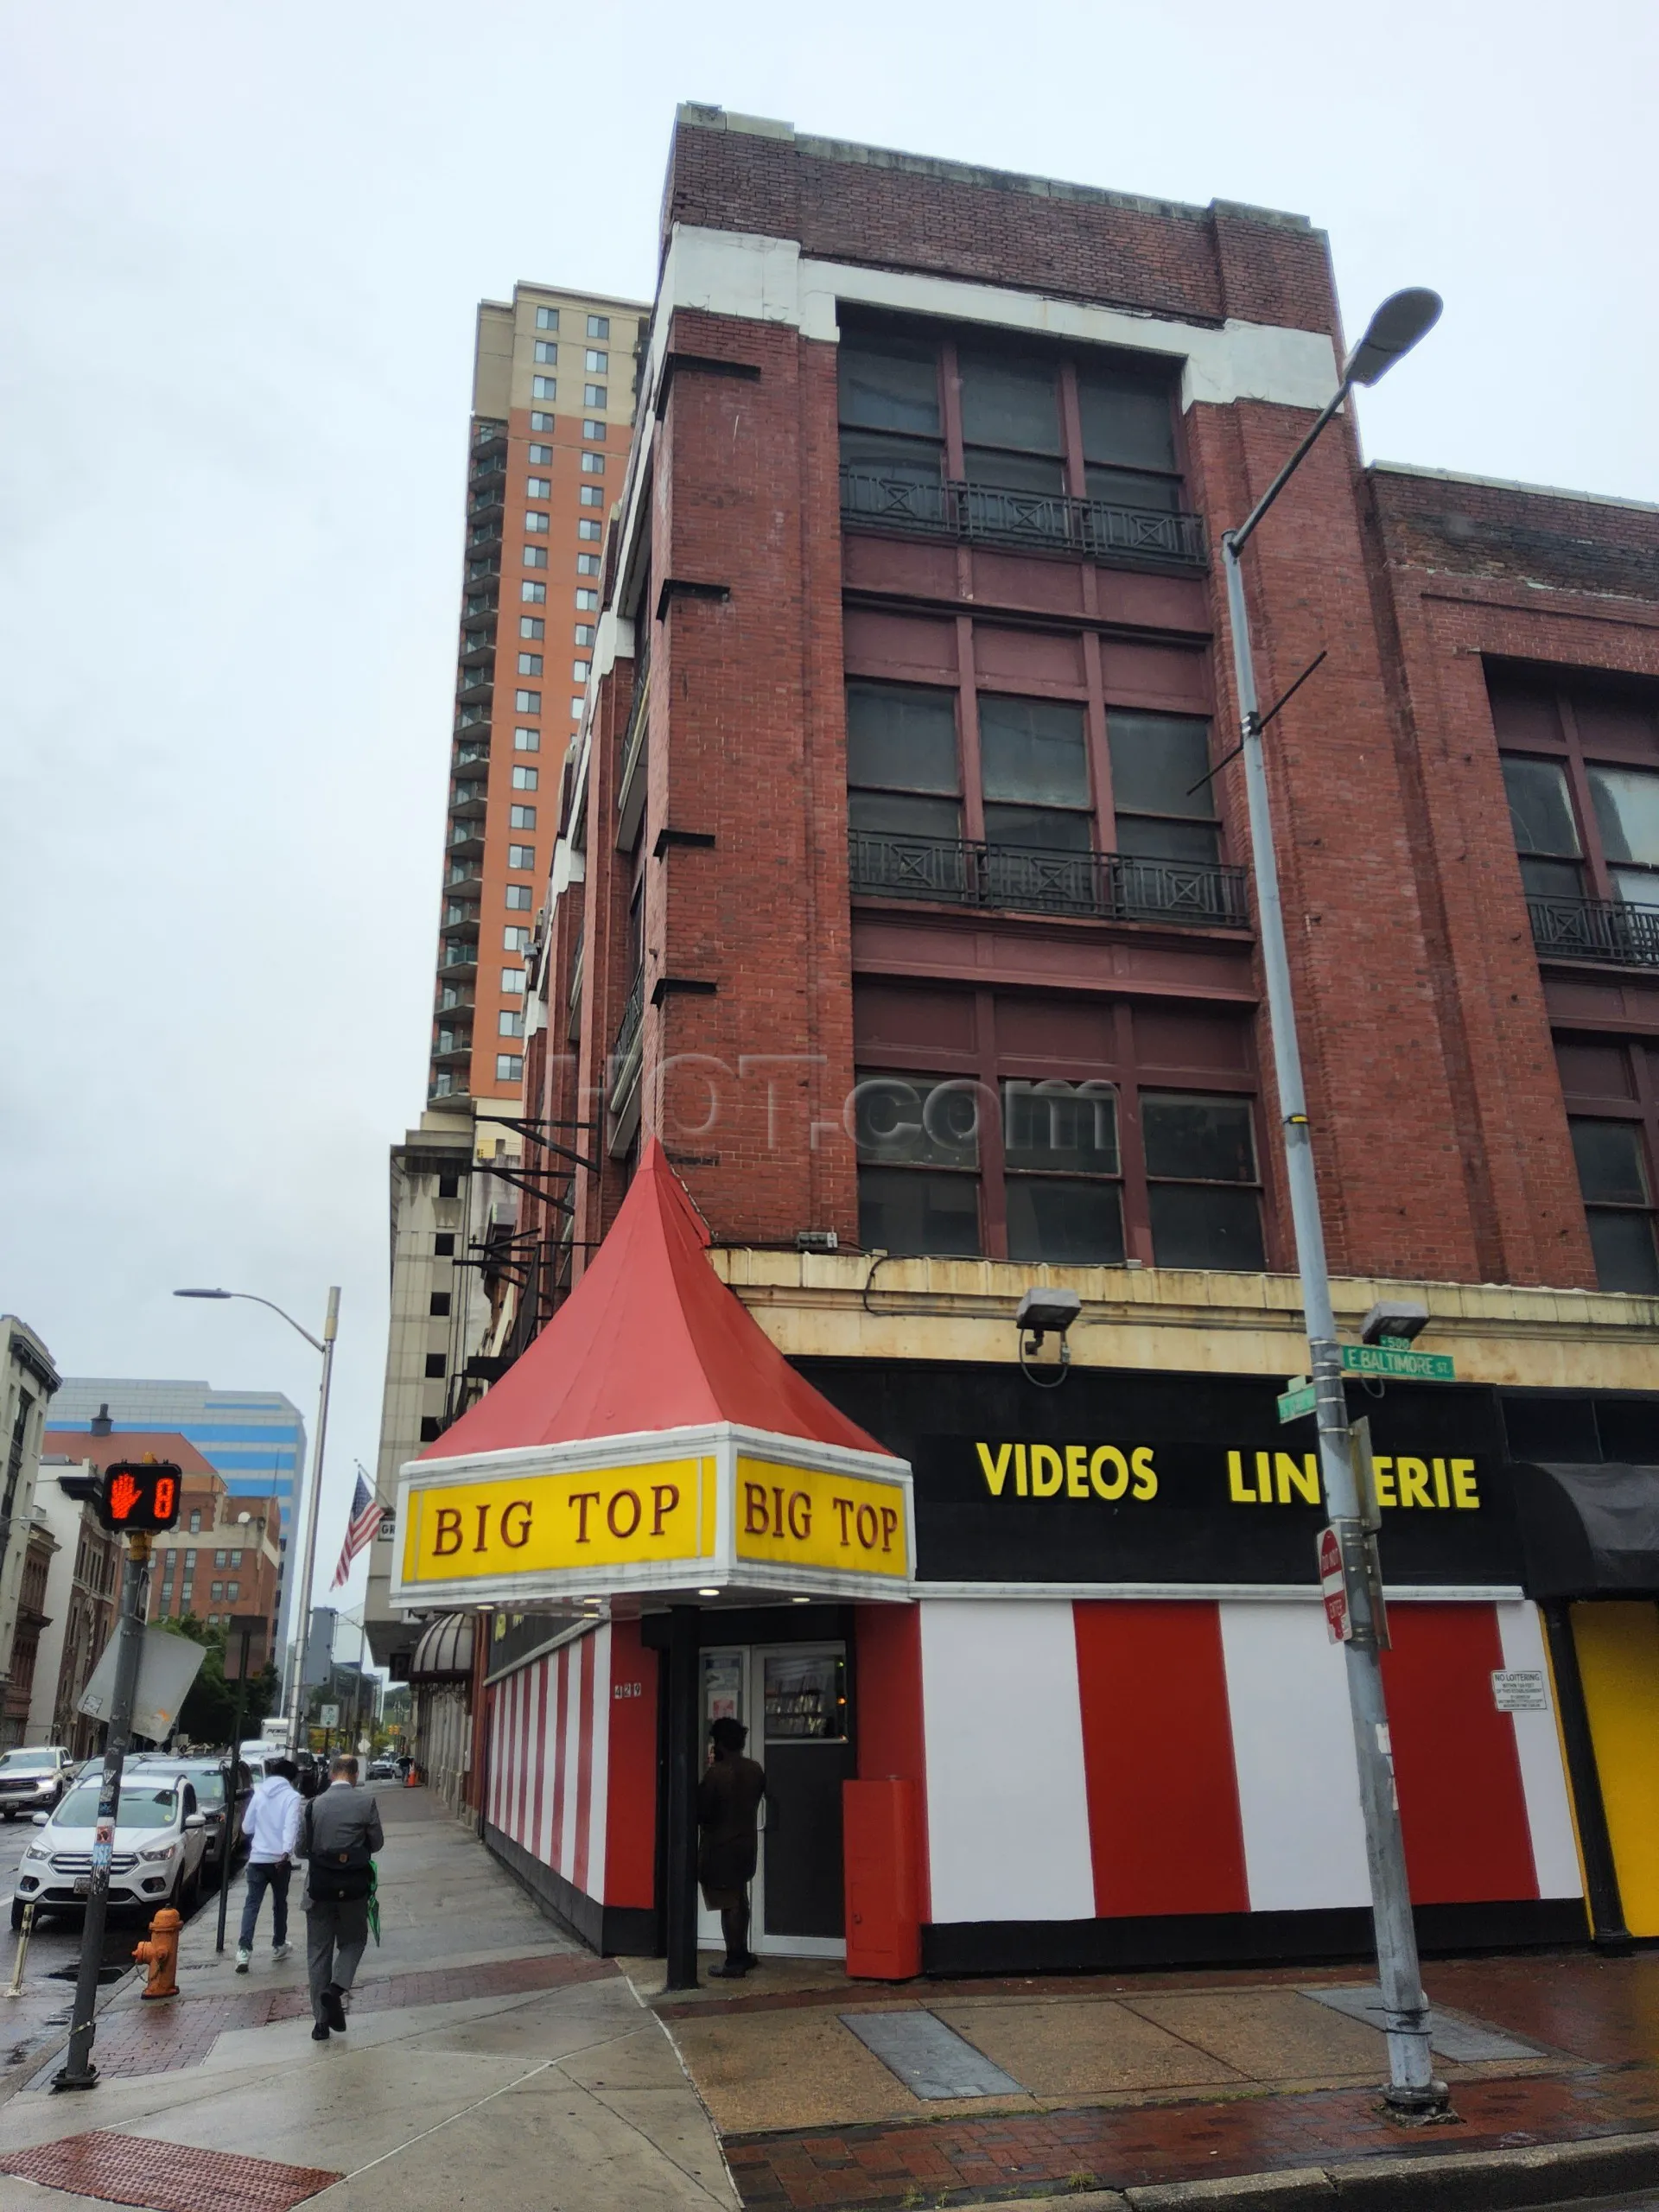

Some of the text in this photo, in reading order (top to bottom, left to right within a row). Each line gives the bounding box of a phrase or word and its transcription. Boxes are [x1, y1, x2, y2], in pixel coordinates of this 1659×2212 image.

[1360, 1351, 1434, 1375] BALTIMORE
[976, 1443, 1480, 1508] VIDEOS LINERIE
[432, 1484, 679, 1556] BIG TOP
[743, 1481, 898, 1553] BIG TOP
[615, 1683, 640, 1698] 429
